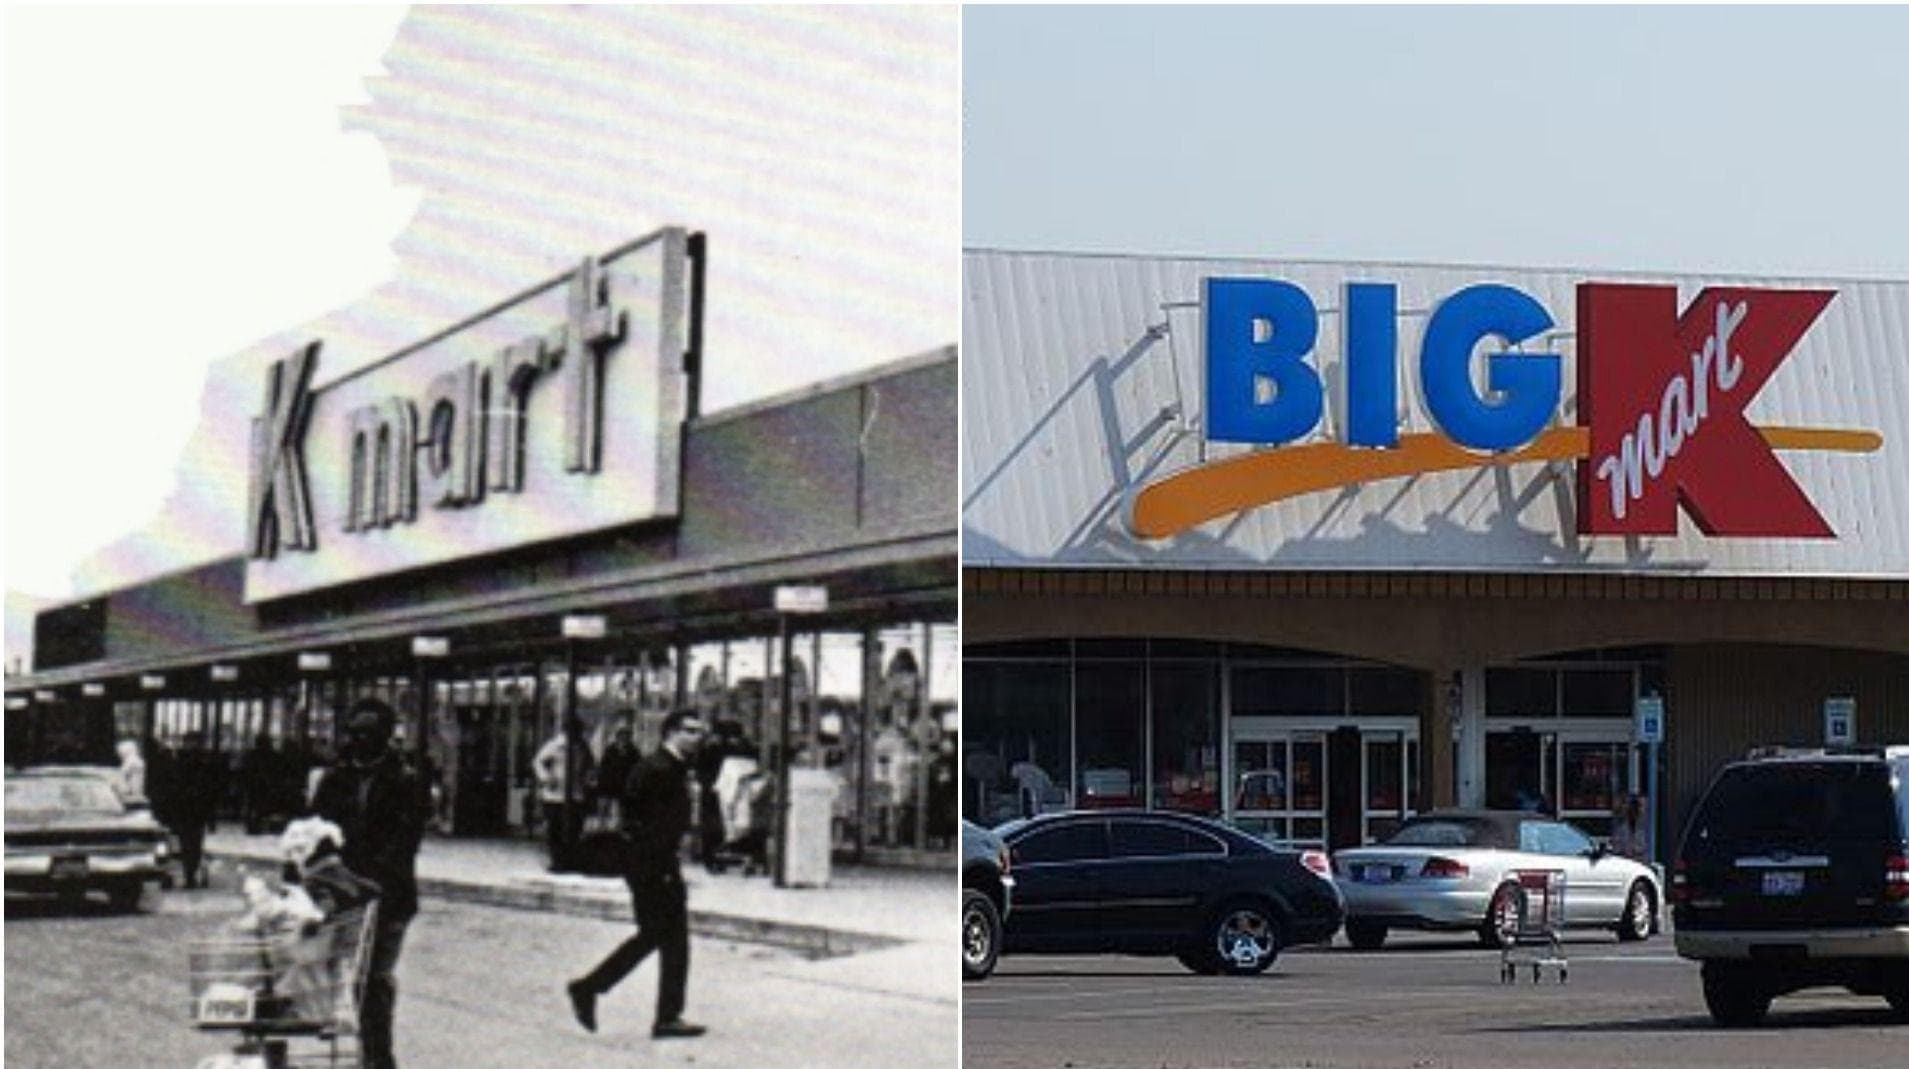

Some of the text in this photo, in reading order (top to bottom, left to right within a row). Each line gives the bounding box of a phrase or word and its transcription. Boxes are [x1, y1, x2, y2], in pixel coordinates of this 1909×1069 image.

[248, 256, 629, 561] K mart
[1203, 275, 1838, 537] BIG K
[1598, 300, 1748, 519] mart
